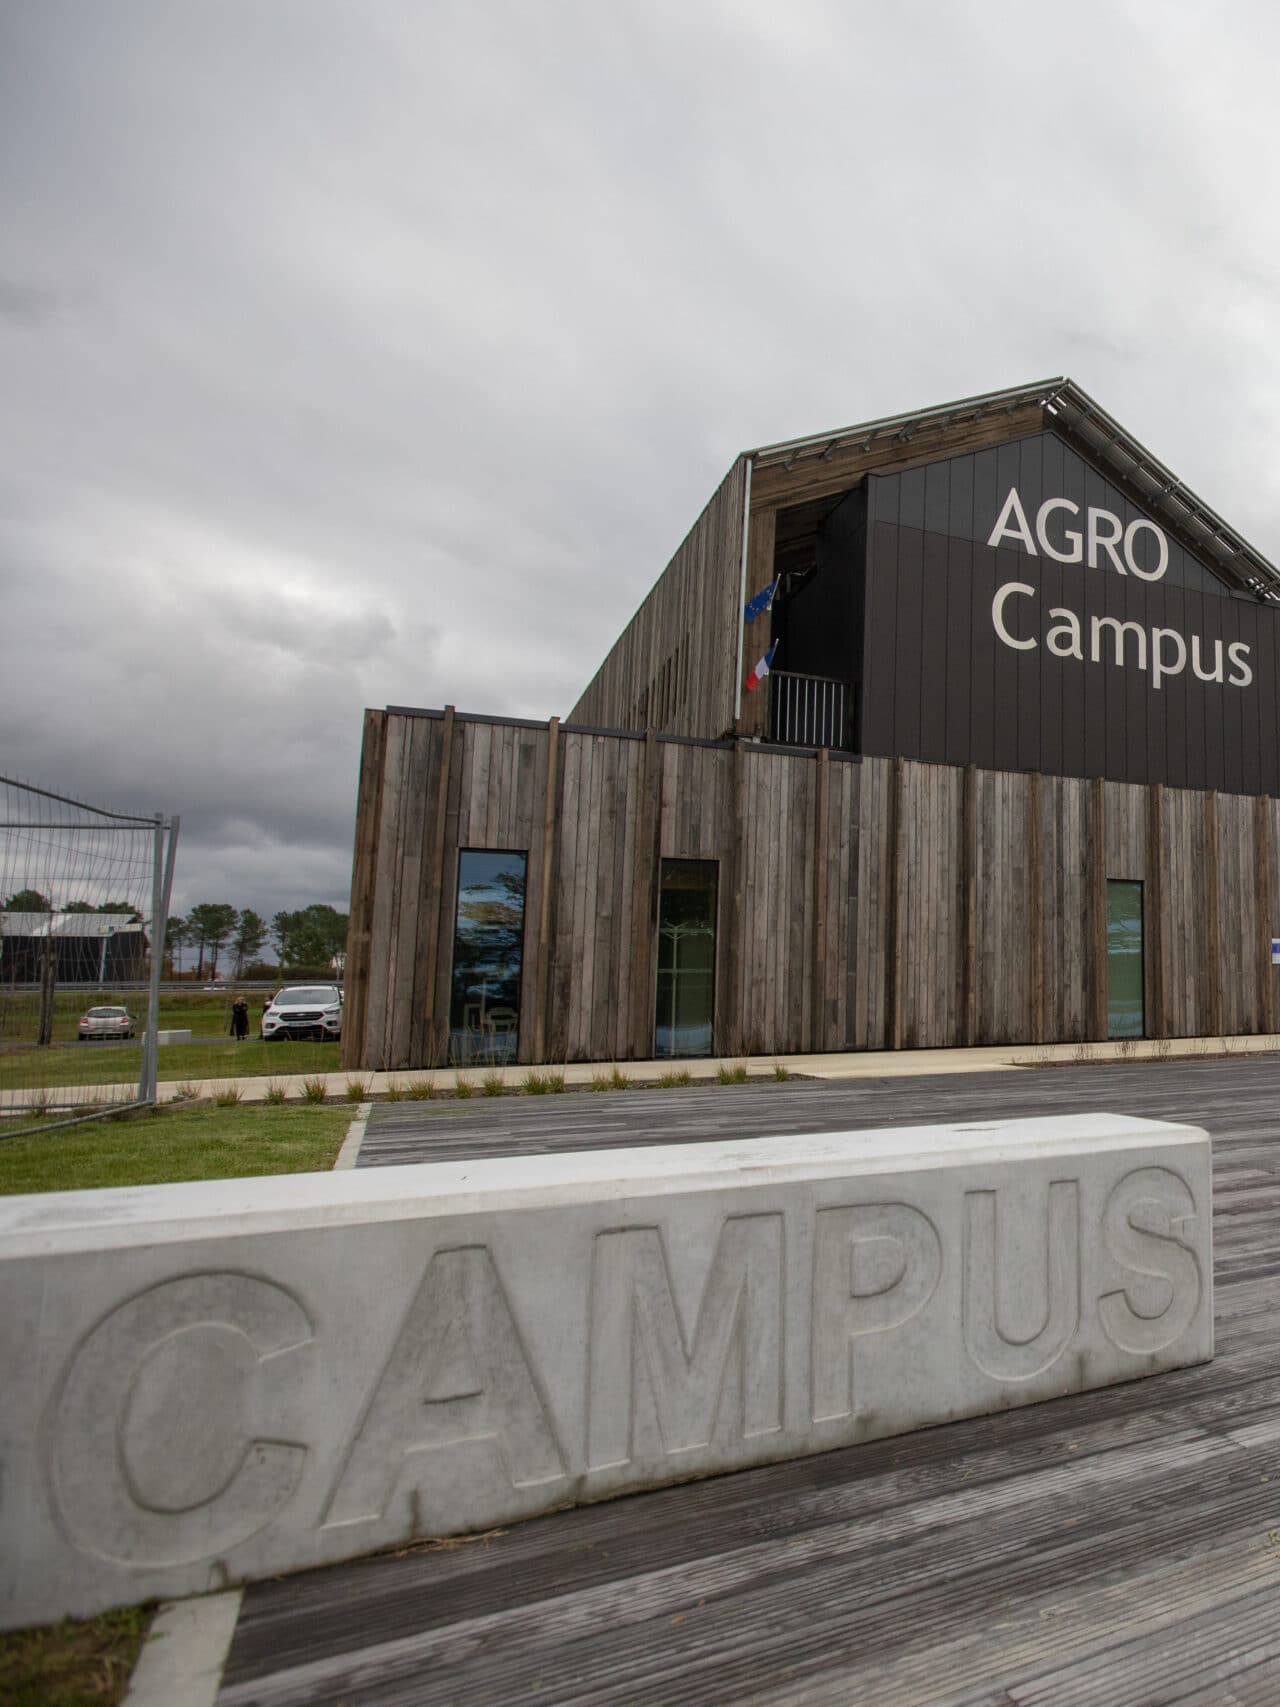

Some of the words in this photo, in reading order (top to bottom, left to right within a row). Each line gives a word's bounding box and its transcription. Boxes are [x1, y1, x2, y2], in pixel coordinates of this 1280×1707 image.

[987, 487, 1169, 582] AGRO
[991, 581, 1253, 689] Campus
[38, 1165, 1203, 1569] CAMPUS
